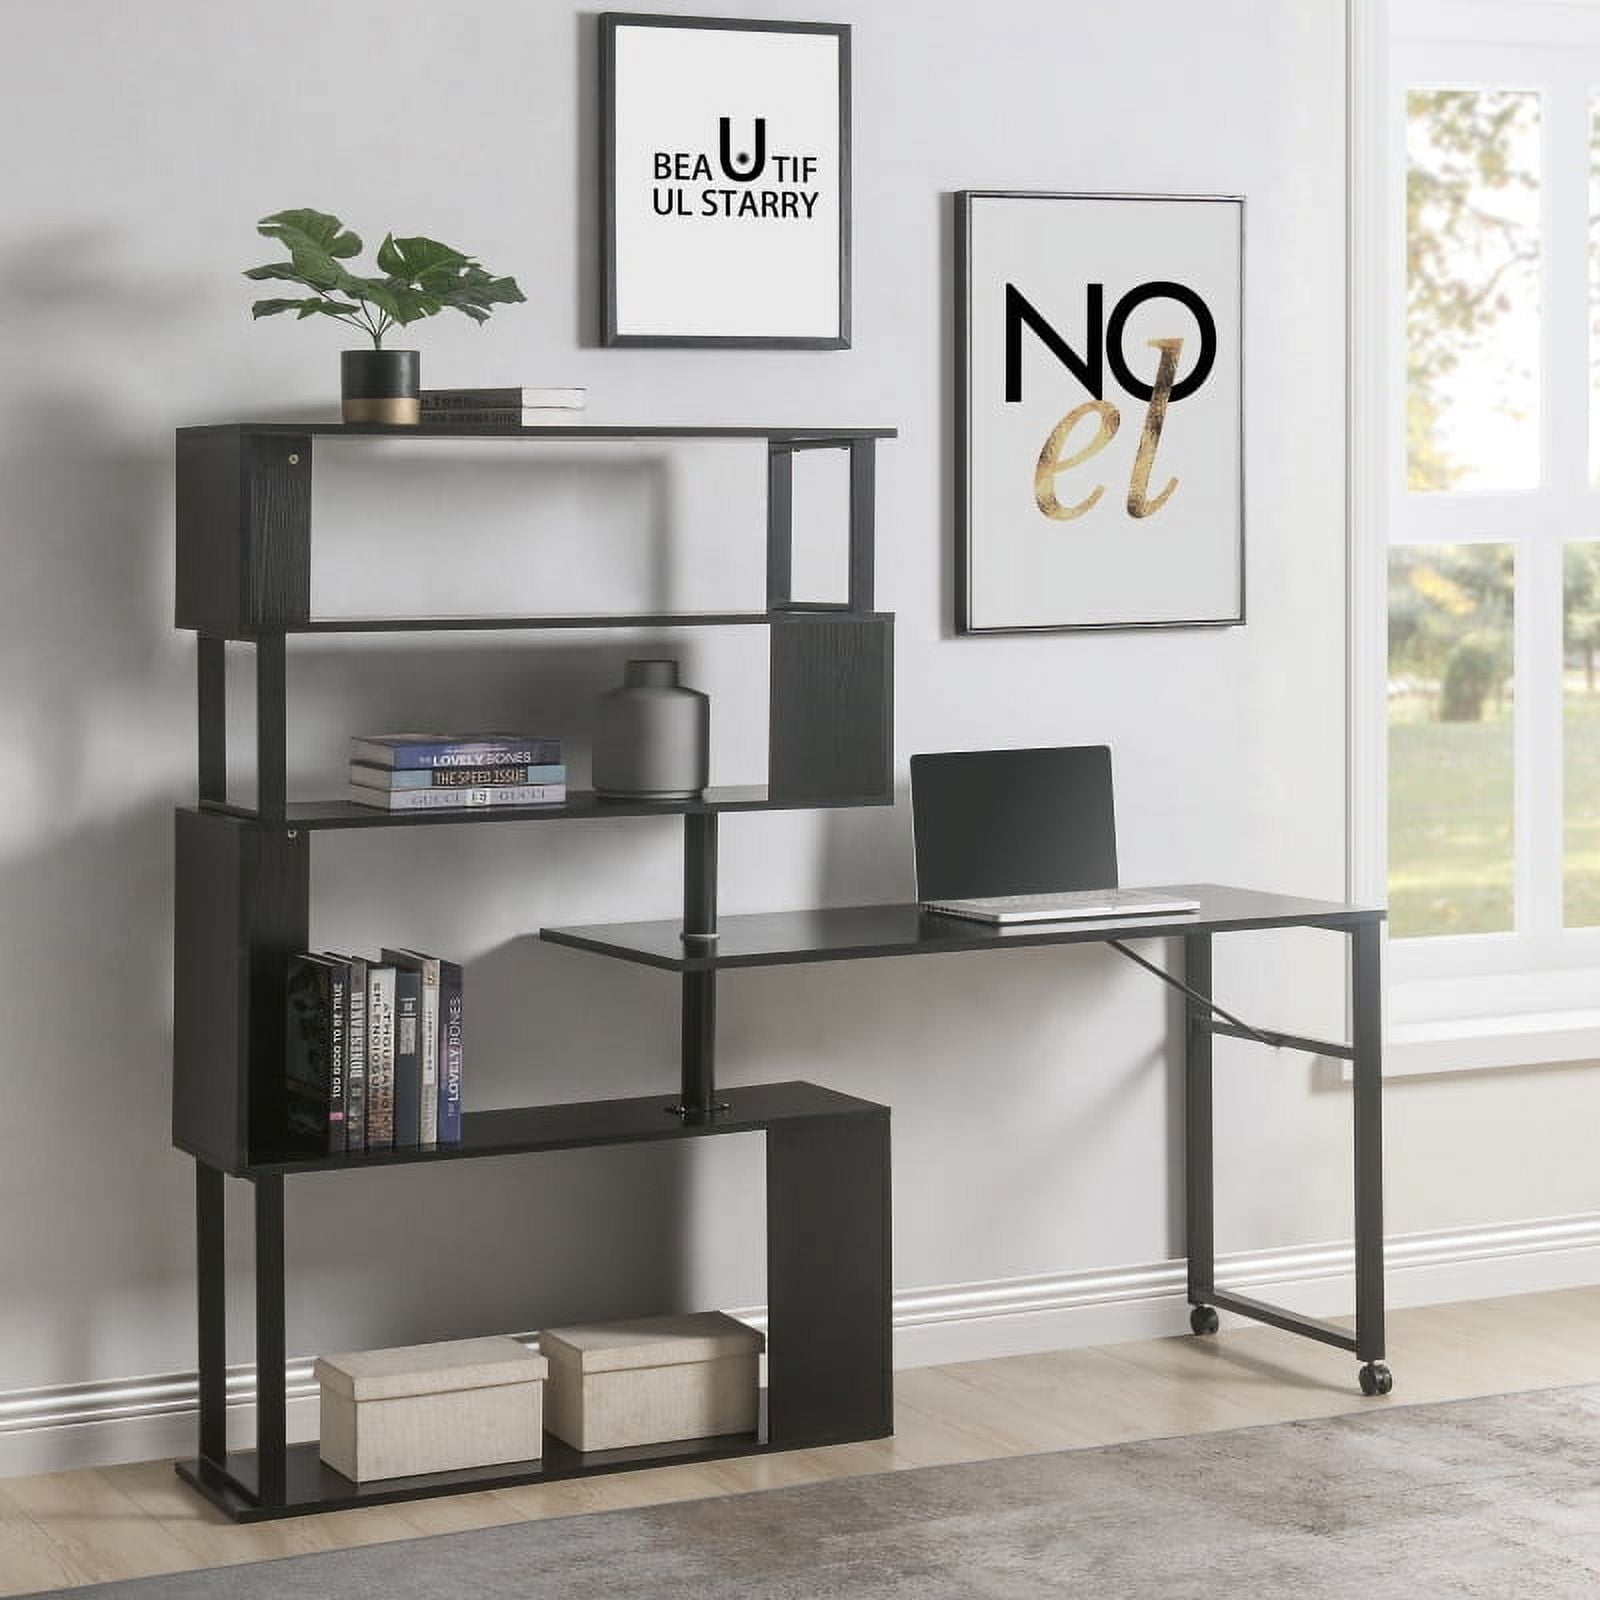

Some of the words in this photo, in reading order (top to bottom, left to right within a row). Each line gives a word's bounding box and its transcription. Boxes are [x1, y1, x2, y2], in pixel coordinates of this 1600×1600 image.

[654, 153, 713, 181] BEA
[719, 117, 766, 182] U
[771, 156, 817, 183] TIF
[653, 188, 693, 216] UL
[702, 189, 819, 219] STARRY
[1005, 281, 1217, 403] NO
[433, 754, 483, 767] LOVELY
[486, 751, 532, 764] BONES
[435, 771, 455, 785] THE
[493, 768, 527, 782] ISSUE
[332, 982, 344, 1010] TRUE
[332, 1029, 343, 1043] TO
[449, 997, 462, 1047] BONES
[447, 1048, 461, 1102] LOVELY
